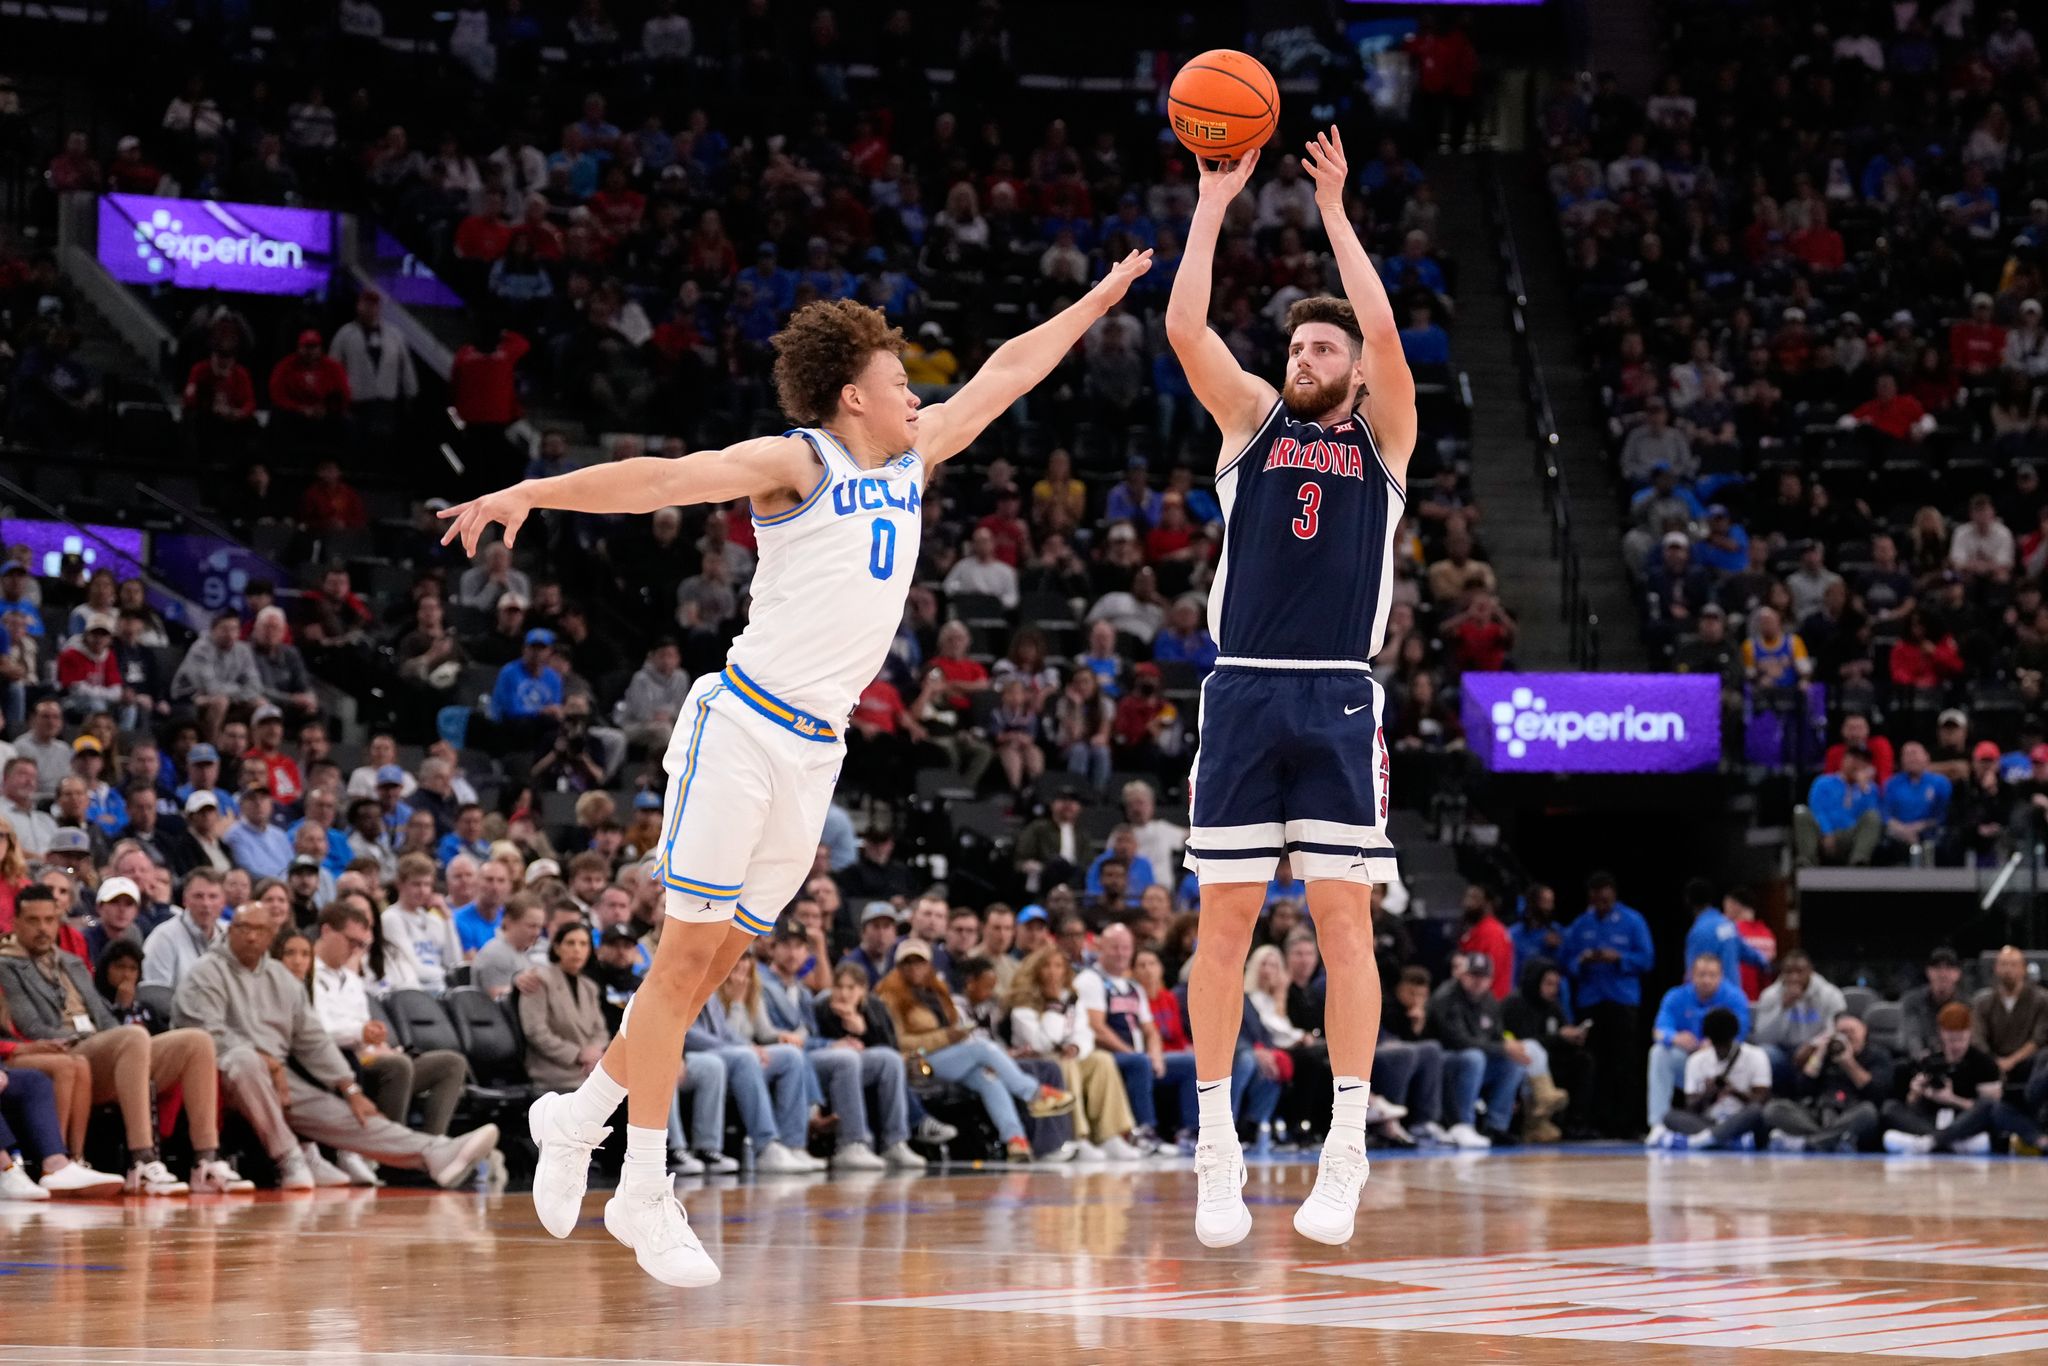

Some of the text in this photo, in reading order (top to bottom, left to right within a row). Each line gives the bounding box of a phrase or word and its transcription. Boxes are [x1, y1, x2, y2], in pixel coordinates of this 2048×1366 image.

[1175, 115, 1227, 141] ELITE
[155, 232, 303, 269] experian
[1263, 437, 1364, 481] ARIZONA
[832, 477, 921, 517] UCLA
[1292, 481, 1322, 539] 3
[869, 517, 896, 580] 0
[1514, 704, 1684, 749] experian
